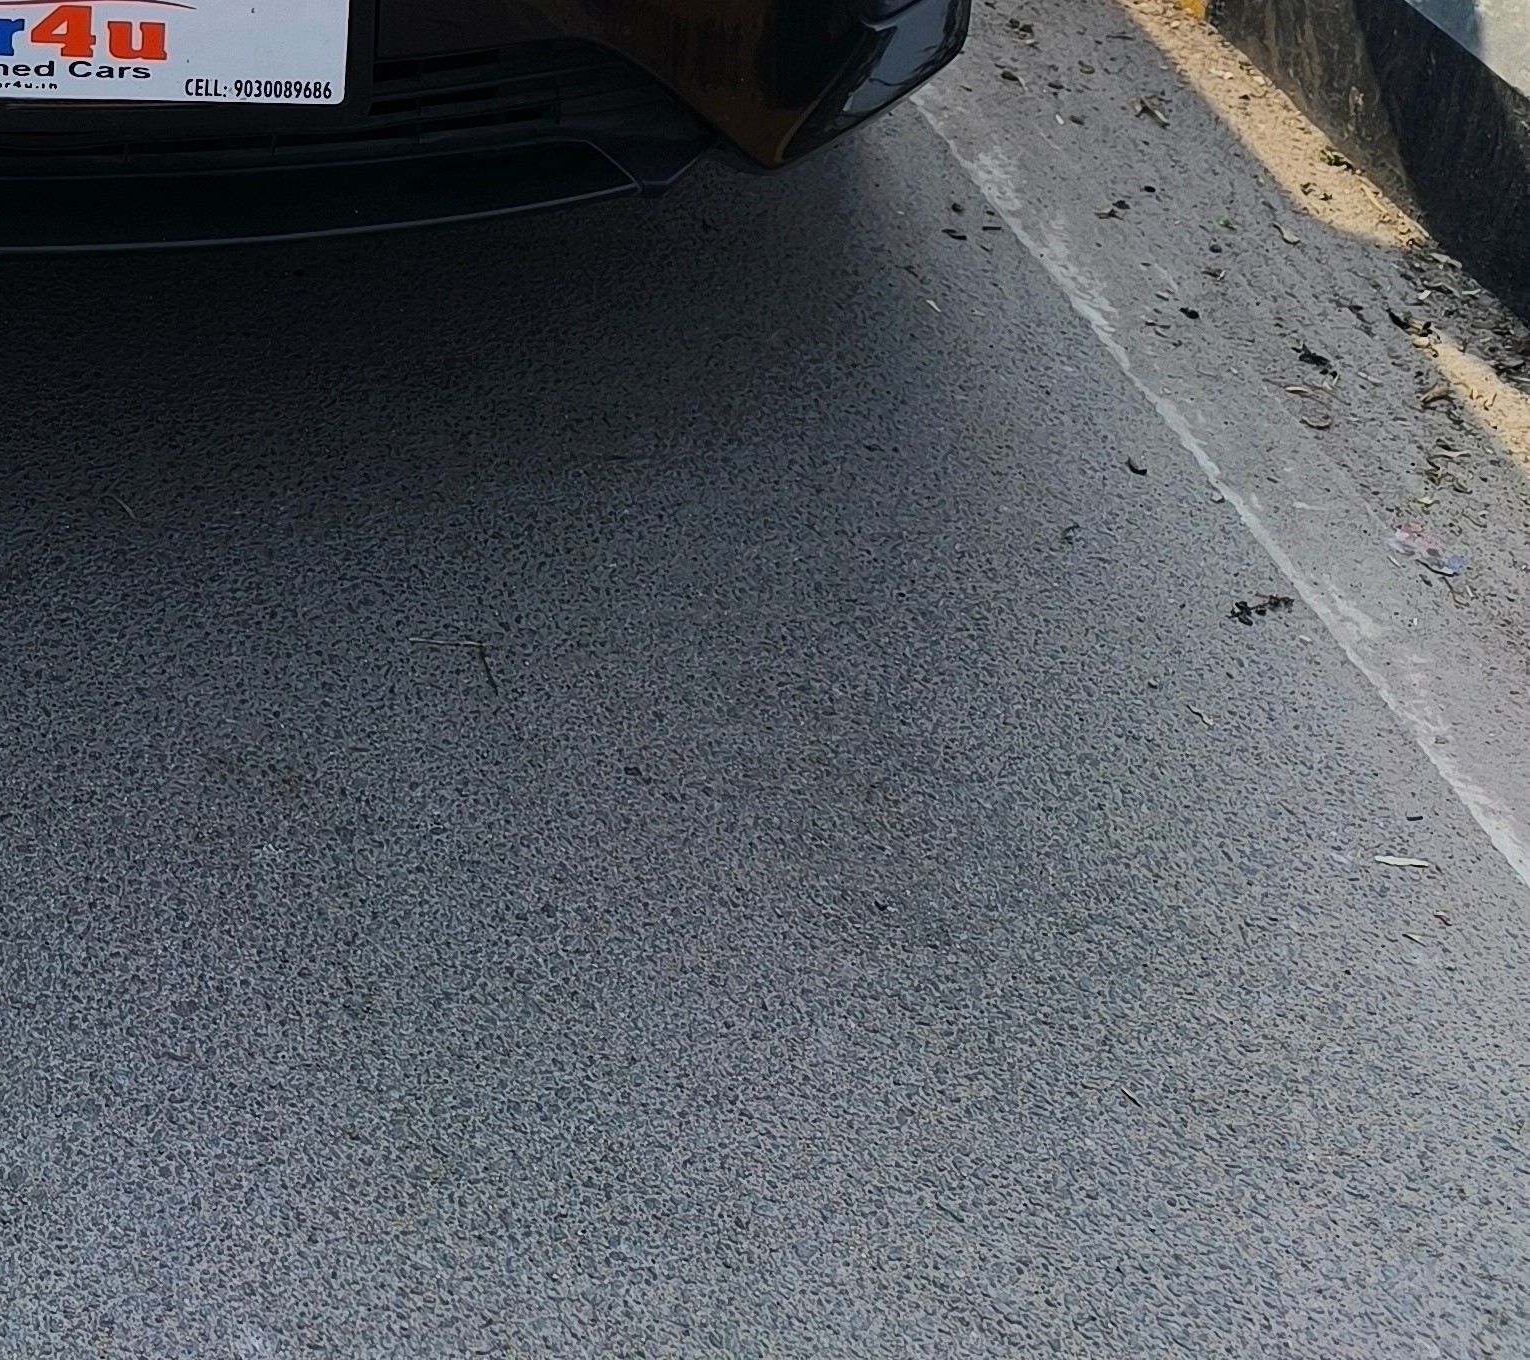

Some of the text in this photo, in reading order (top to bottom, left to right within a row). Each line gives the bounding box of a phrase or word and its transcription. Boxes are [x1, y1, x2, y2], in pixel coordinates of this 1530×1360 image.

[67, 60, 152, 81] Cars
[184, 78, 333, 100] CELL: 9030089686
